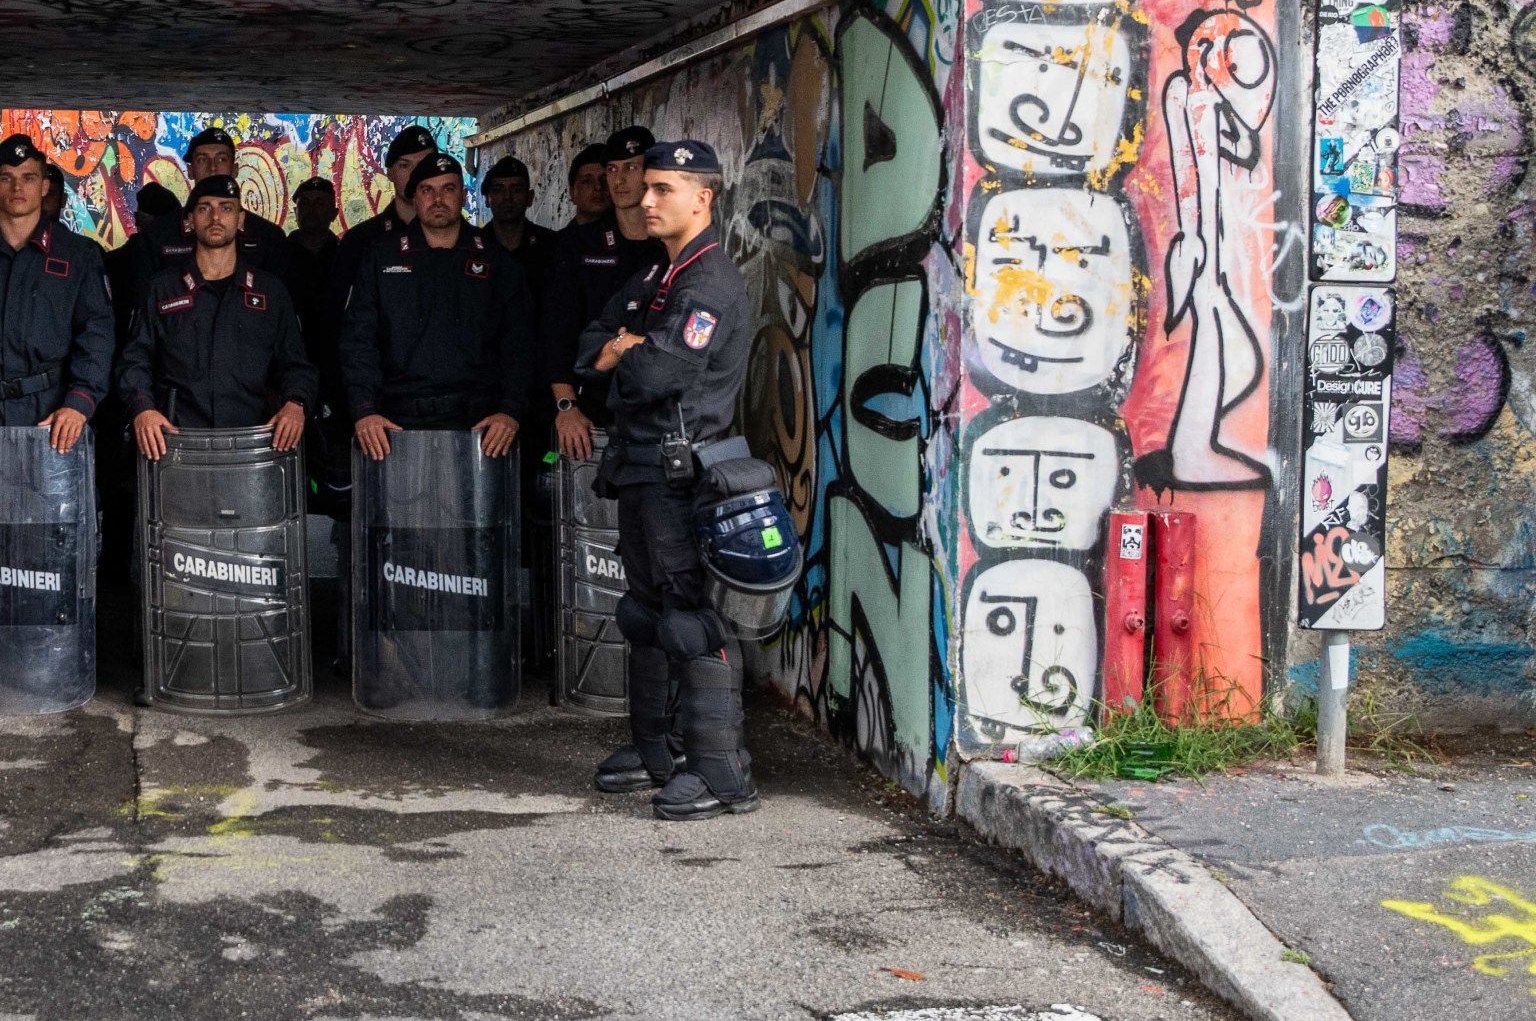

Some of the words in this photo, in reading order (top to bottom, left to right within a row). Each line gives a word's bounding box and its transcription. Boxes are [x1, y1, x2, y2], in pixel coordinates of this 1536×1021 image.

[1317, 97, 1337, 116] THE
[173, 552, 278, 588] CARABINIERI
[383, 562, 488, 598] CARABINIERI
[586, 552, 629, 581] CARA
